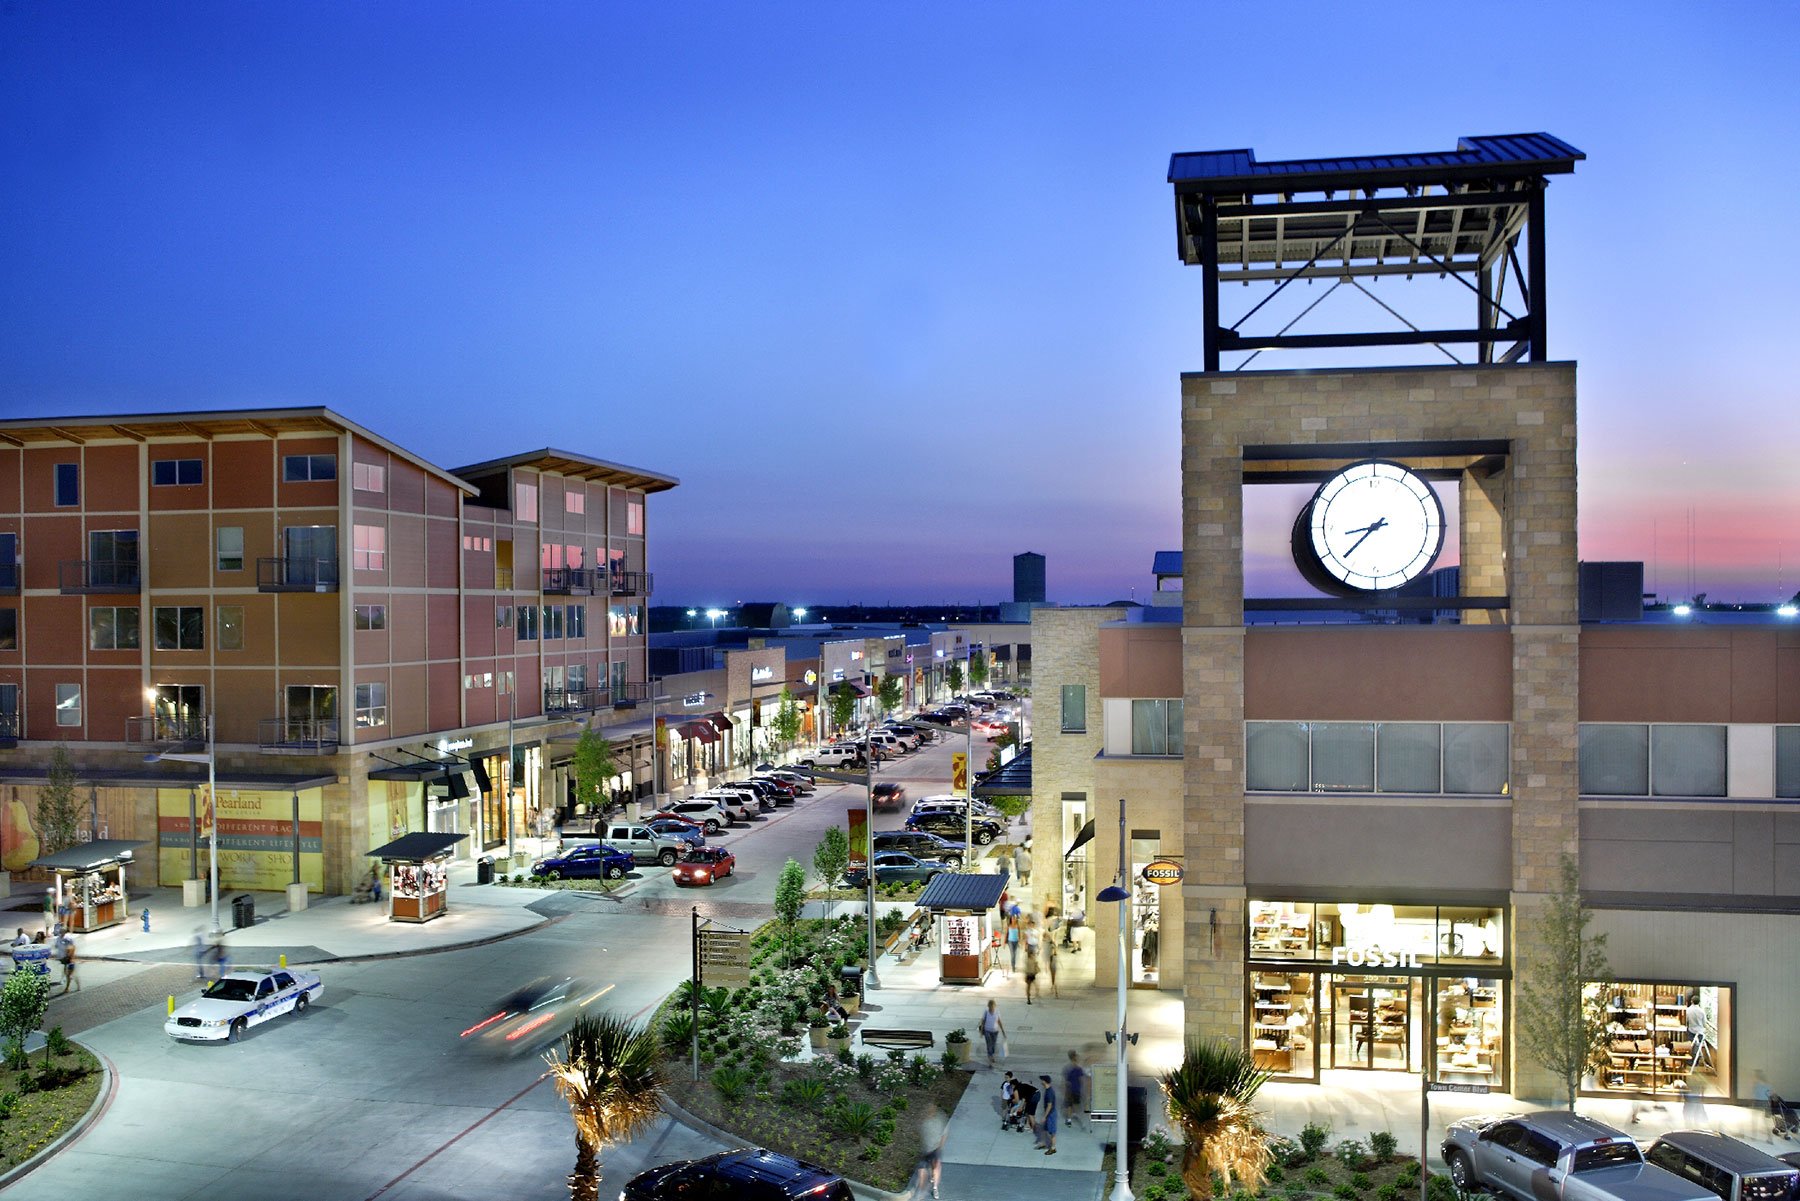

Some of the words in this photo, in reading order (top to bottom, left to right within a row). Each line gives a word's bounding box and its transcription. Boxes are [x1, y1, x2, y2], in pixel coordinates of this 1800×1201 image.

[215, 797, 262, 809] Pearland
[270, 825, 297, 833] PLAC
[269, 840, 318, 849] LIFESYLE
[267, 853, 297, 865] SHO
[1147, 870, 1180, 878] FOSSIL
[1332, 946, 1422, 968] FOSSIL
[1430, 1083, 1447, 1091] Town
[1448, 1084, 1471, 1092] Center
[1472, 1086, 1488, 1094] Blvd
